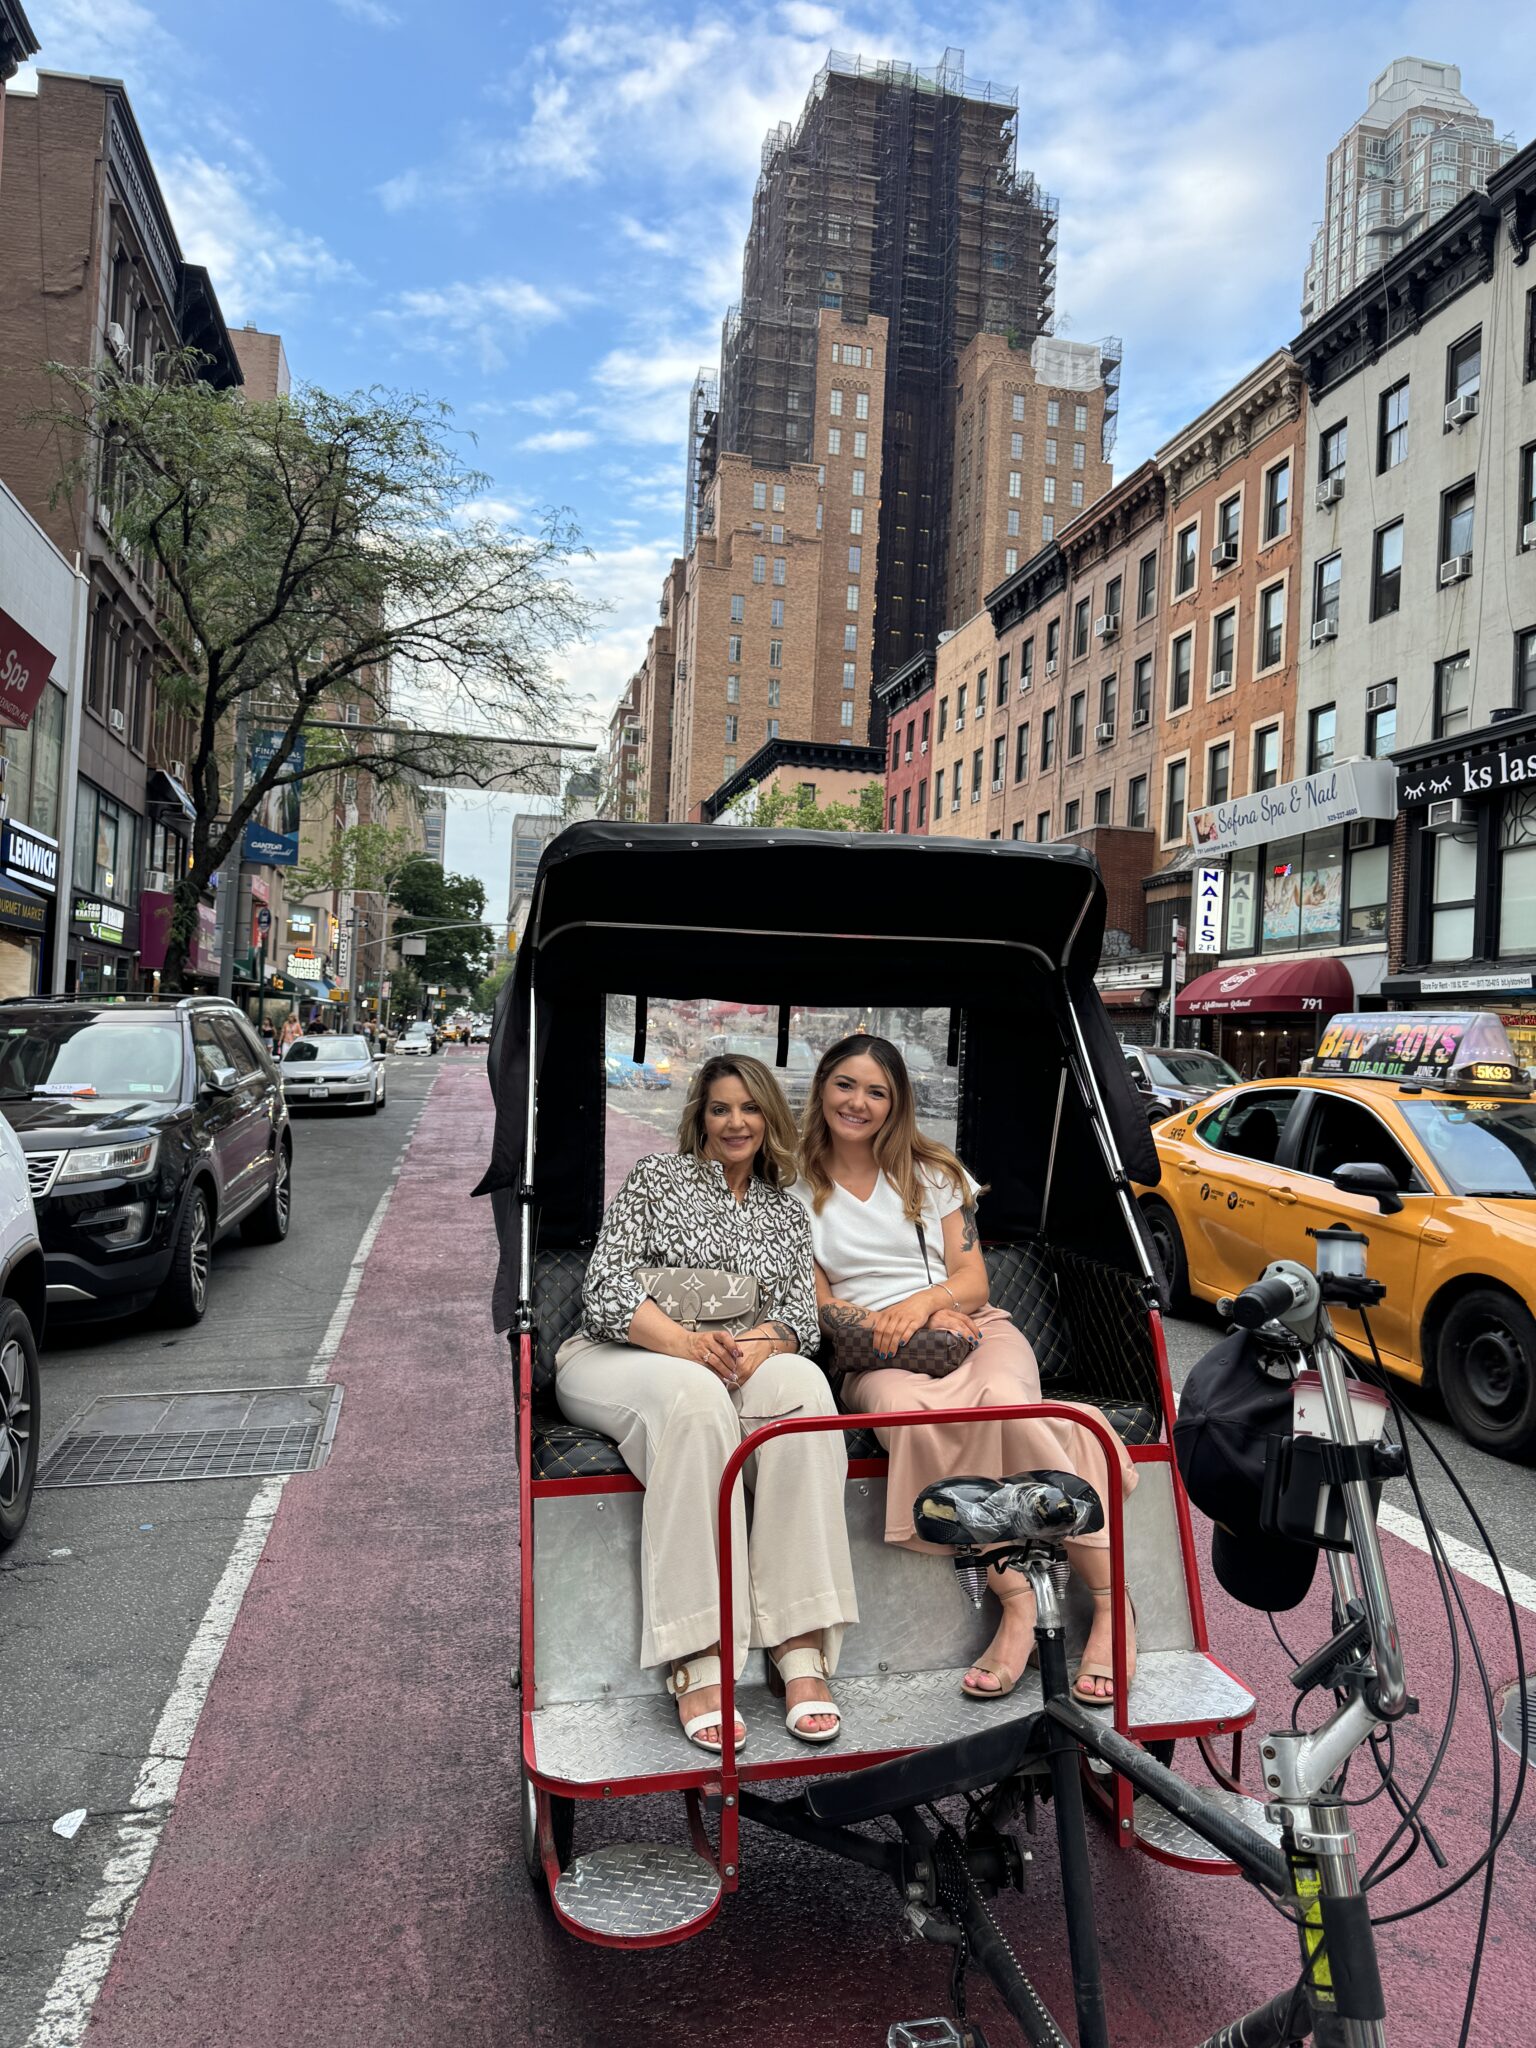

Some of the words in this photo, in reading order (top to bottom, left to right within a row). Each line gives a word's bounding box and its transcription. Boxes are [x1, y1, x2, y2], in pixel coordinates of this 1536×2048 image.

[1, 649, 30, 692] Spa
[1462, 761, 1493, 793] ks
[1218, 804, 1258, 836] Sofina
[1261, 795, 1287, 826] Spa
[1289, 786, 1302, 814] &
[1305, 772, 1338, 809] Nail
[9, 833, 57, 879] LENWICH
[22, 904, 46, 921] MARKET
[1202, 871, 1219, 942] NAILS
[1198, 943, 1204, 951] 2
[1206, 944, 1217, 952] FL
[287, 966, 321, 980] BURGER
[1301, 998, 1322, 1010] 791
[1348, 1060, 1371, 1074] RIDE
[1372, 1061, 1385, 1075] OR
[1387, 1063, 1406, 1076] DIE
[1413, 1065, 1434, 1077] JUNE
[1435, 1067, 1442, 1078] 7
[1477, 1066, 1512, 1080] 5K93
